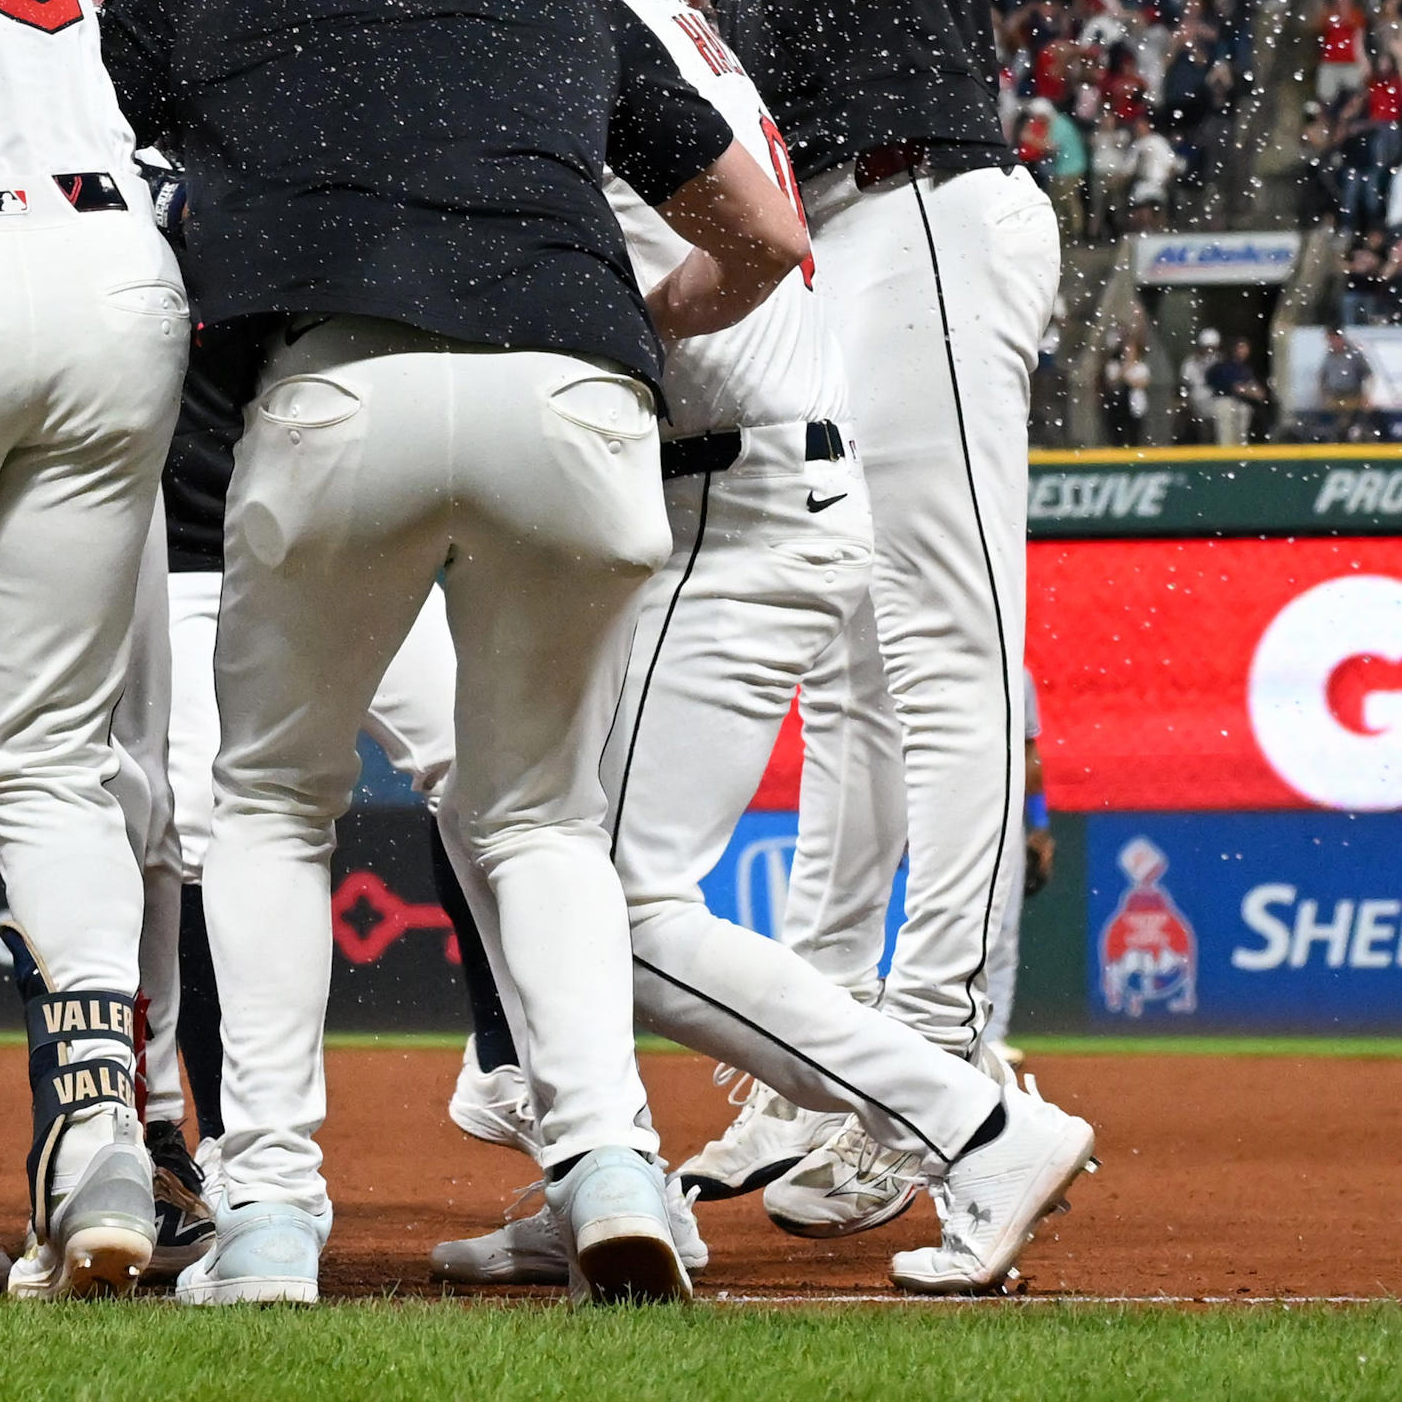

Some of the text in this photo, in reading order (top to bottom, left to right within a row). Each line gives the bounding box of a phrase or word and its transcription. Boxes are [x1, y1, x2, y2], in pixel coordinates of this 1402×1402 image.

[1028, 471, 1174, 520] ESSIVE
[1231, 883, 1402, 971] SHE
[42, 999, 134, 1044] VALER
